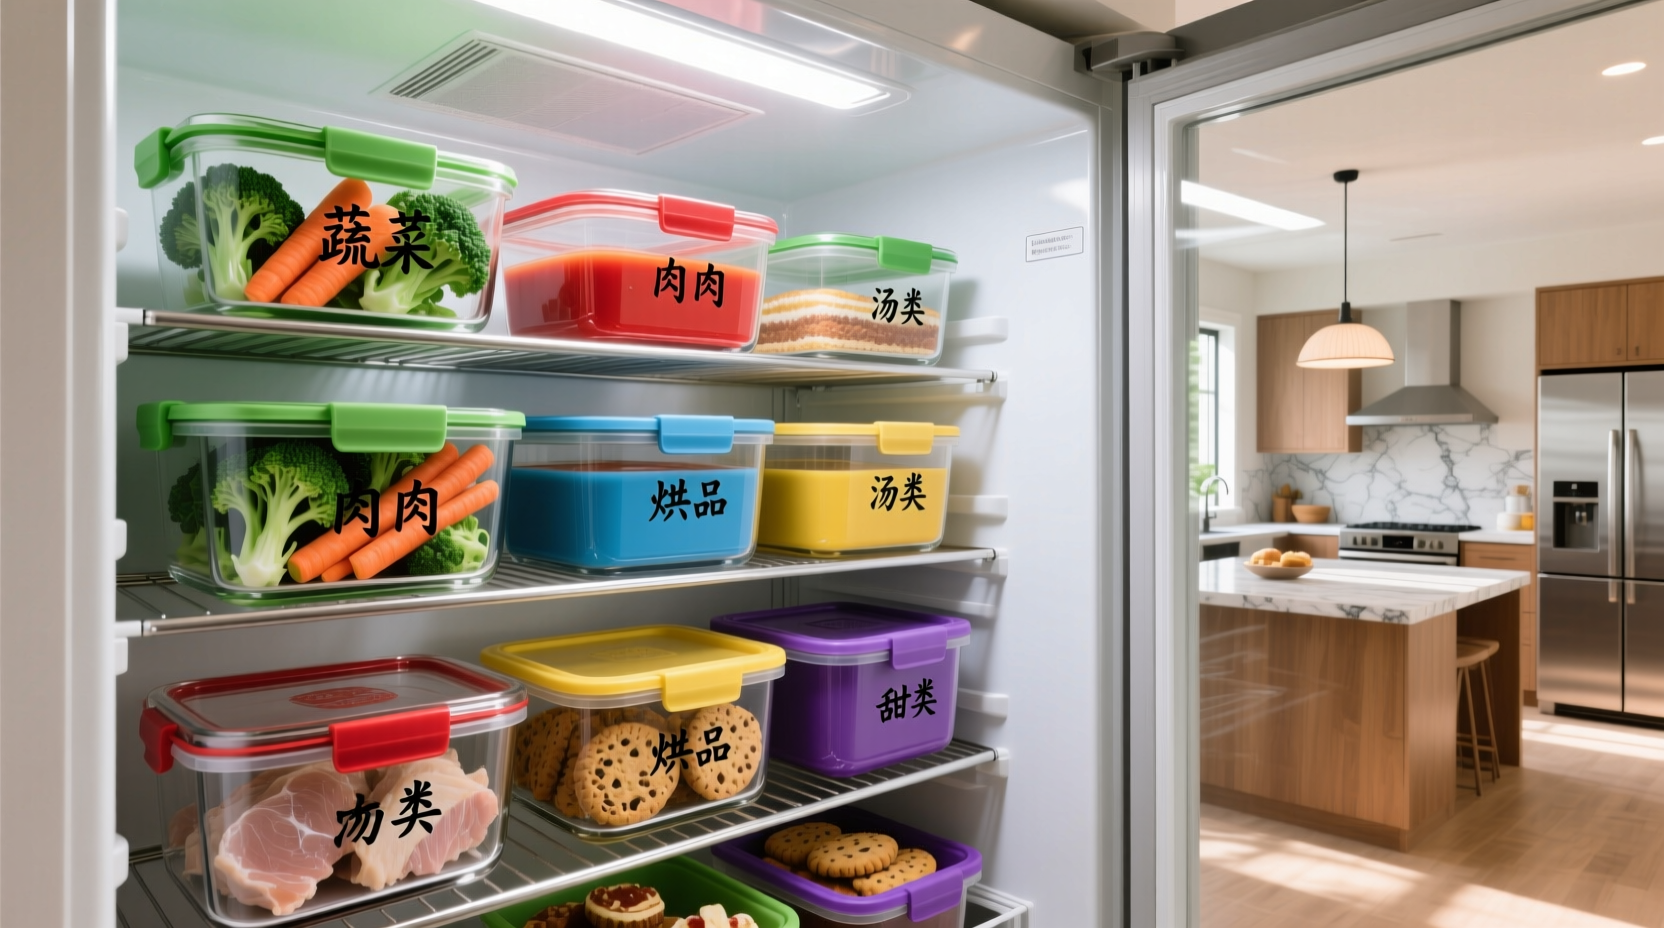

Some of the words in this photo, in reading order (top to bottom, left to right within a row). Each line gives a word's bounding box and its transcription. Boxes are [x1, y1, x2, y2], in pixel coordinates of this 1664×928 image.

[318, 203, 434, 275] 蔬菜
[654, 257, 725, 308] 肉肉
[872, 287, 925, 326] 汤类
[334, 479, 438, 538] 肉肉
[649, 478, 727, 522] 烘品
[870, 472, 926, 511] 汤类
[876, 678, 937, 723] 甜类
[650, 726, 731, 776] 烘品
